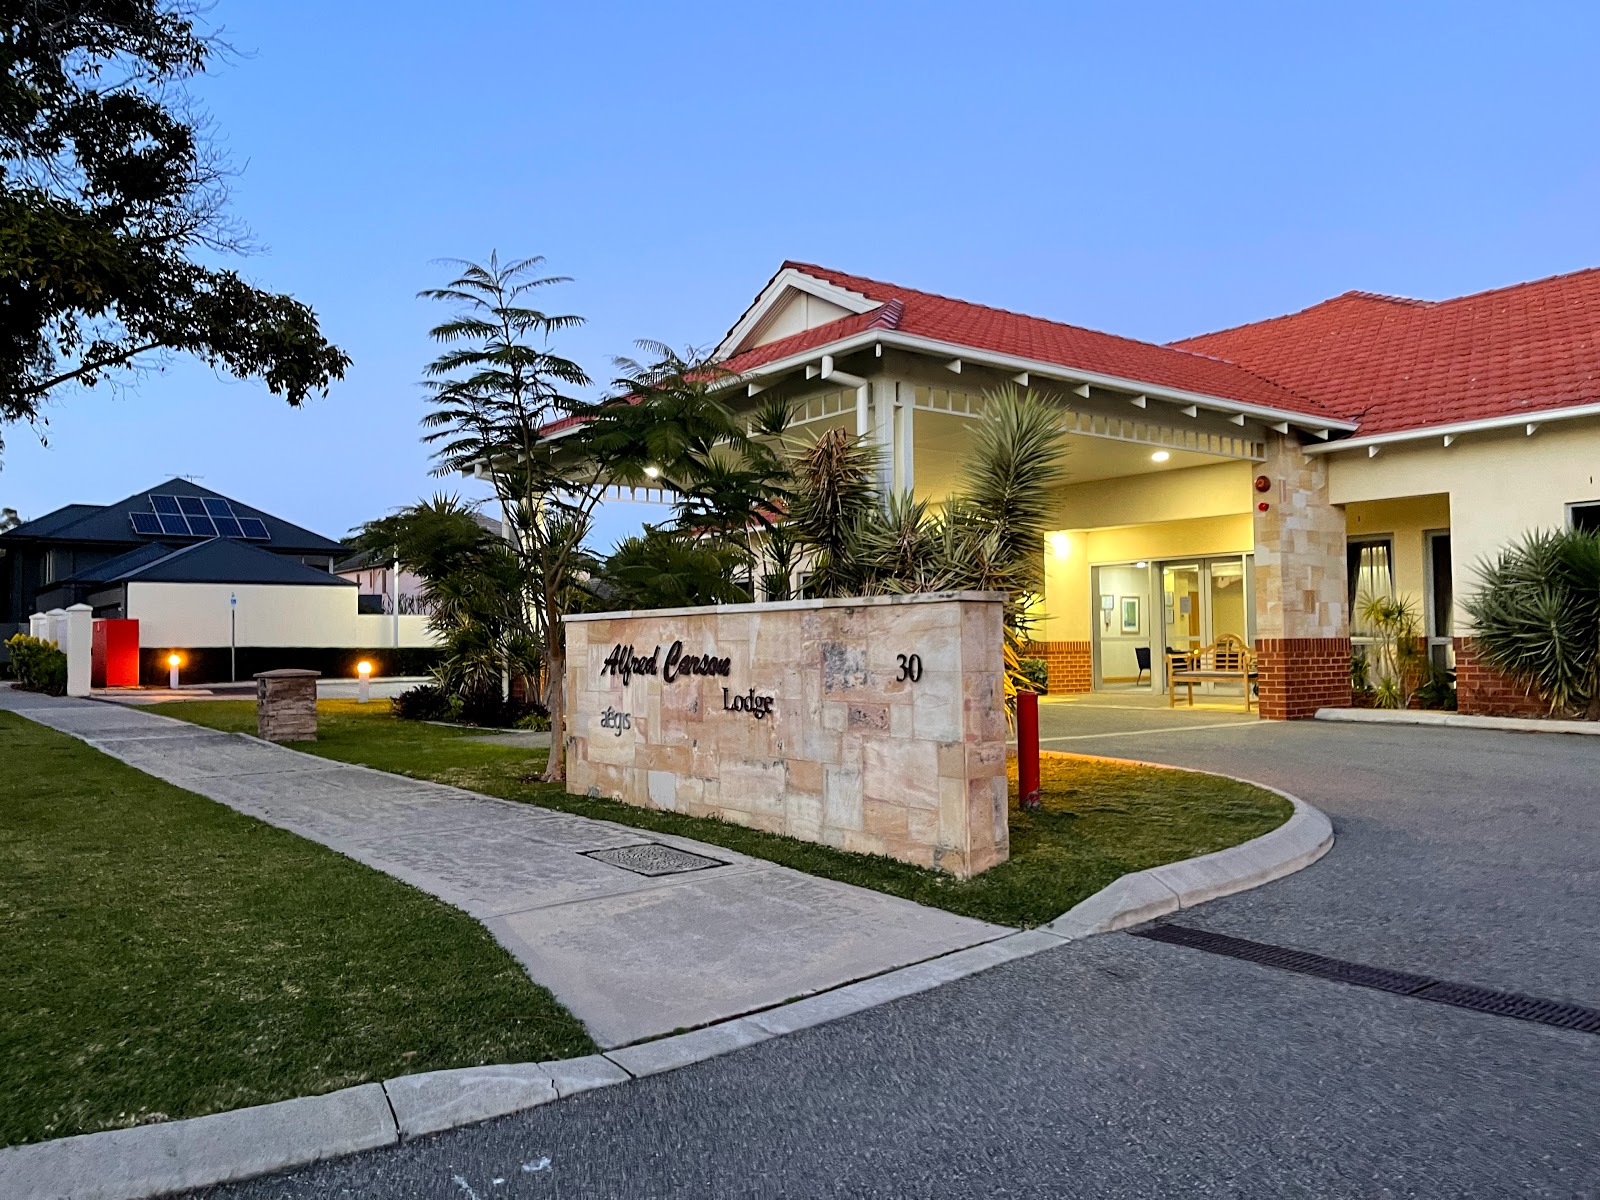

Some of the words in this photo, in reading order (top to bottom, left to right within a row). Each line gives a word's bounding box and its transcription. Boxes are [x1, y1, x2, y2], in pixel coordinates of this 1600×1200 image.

[601, 643, 660, 686] Alfred
[663, 640, 731, 683] Carson
[896, 653, 923, 682] 30
[722, 687, 774, 719] Lodge
